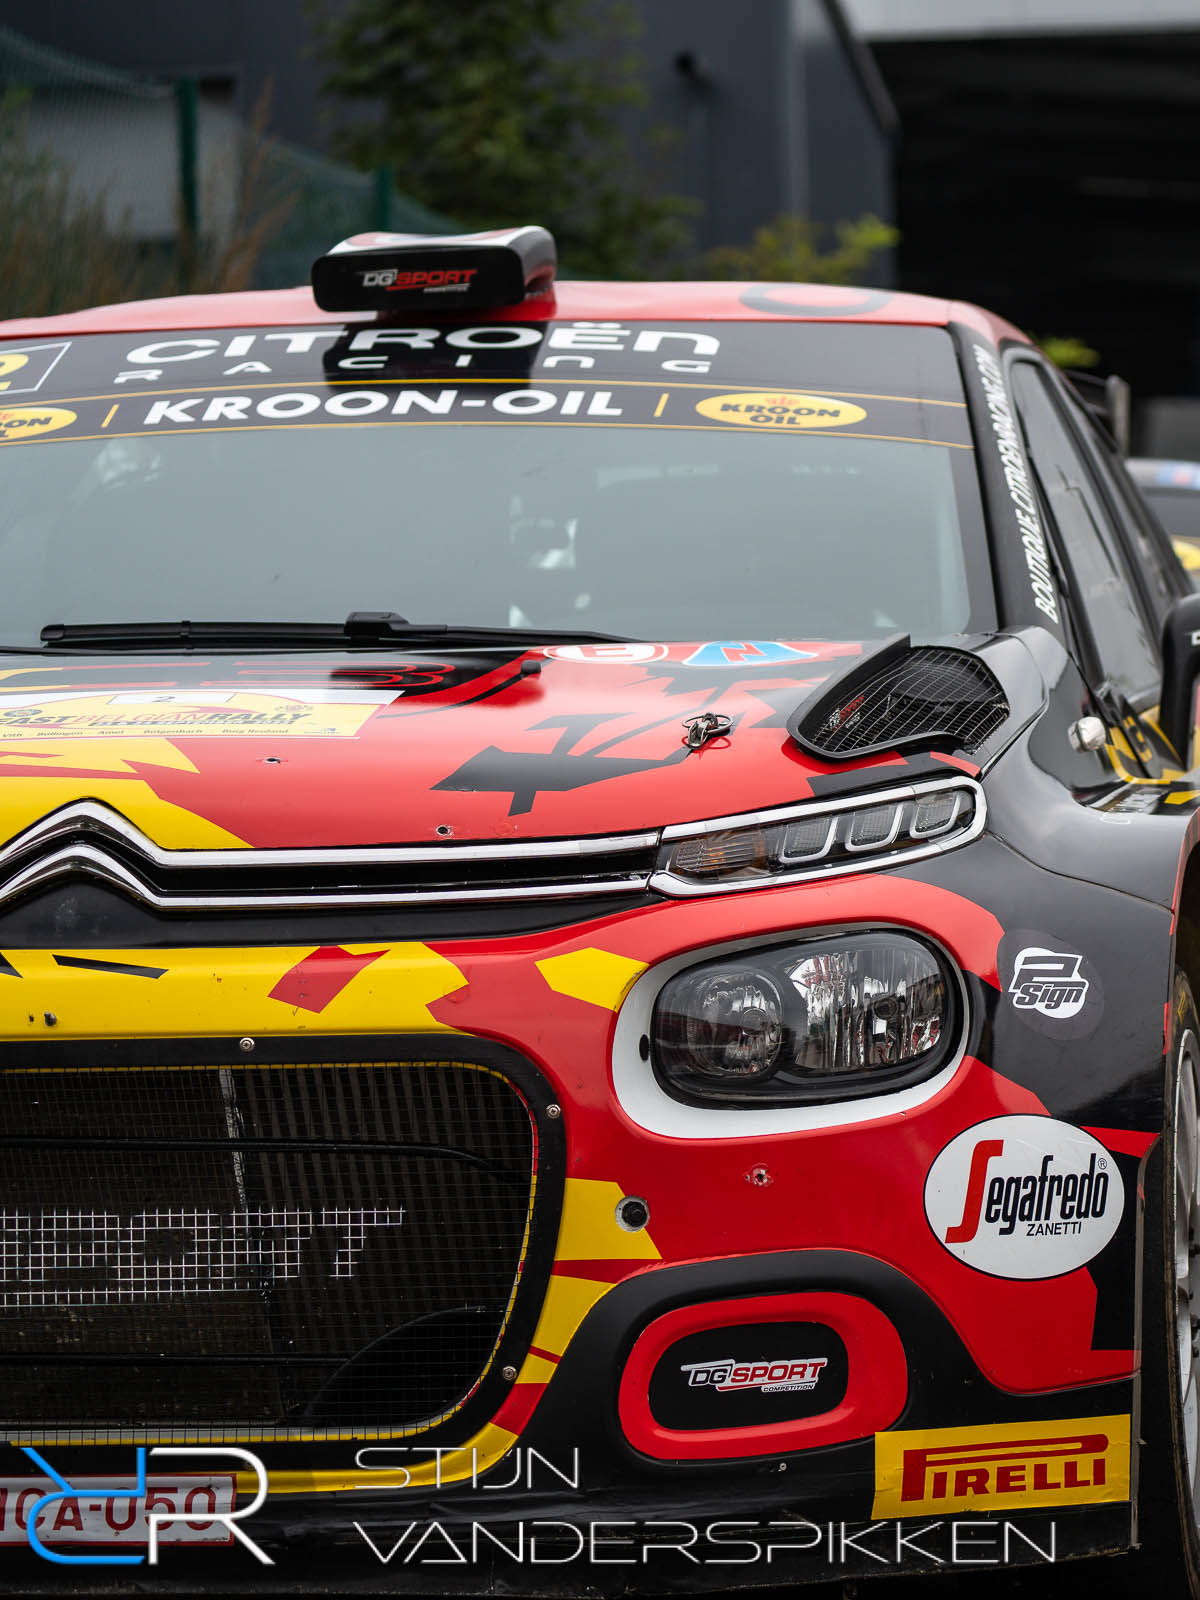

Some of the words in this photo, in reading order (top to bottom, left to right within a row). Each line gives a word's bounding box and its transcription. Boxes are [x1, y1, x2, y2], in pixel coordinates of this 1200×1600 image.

[114, 354, 711, 384] RACING
[142, 389, 623, 425] KROON-OIL
[720, 403, 840, 418] KROON
[750, 414, 801, 425] OIL
[1015, 984, 1084, 1010] Sign
[945, 1139, 1110, 1243] Segafredo
[1026, 1221, 1082, 1237] ZANETTI
[763, 1384, 814, 1392] COMPETITION
[900, 1434, 1109, 1502] PIRELLI
